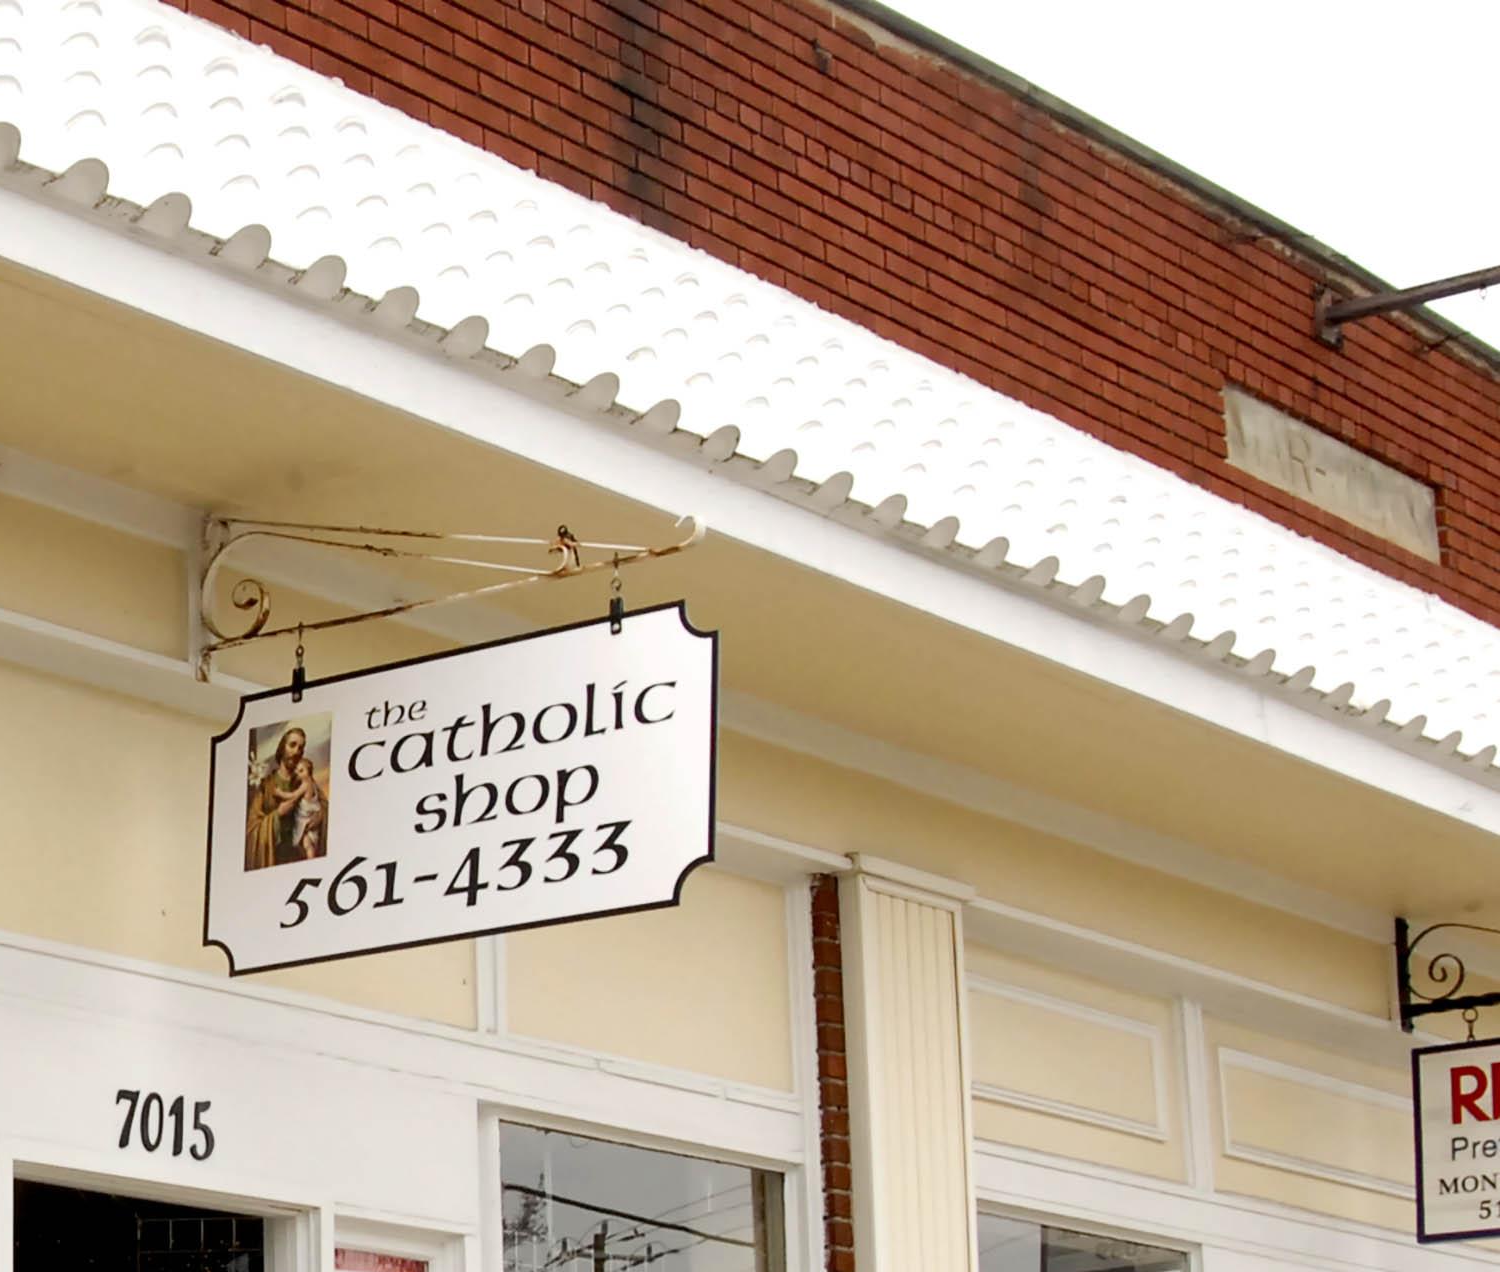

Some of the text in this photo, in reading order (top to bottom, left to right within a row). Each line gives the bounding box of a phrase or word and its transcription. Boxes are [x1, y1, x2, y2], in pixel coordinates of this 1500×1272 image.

[347, 680, 678, 782] catholic
[366, 699, 427, 730] the
[414, 764, 599, 834] shop
[279, 819, 633, 929] 561-4333
[115, 1089, 216, 1161] 7015
[1450, 1062, 1500, 1125] R
[1451, 1137, 1500, 1162] Pre
